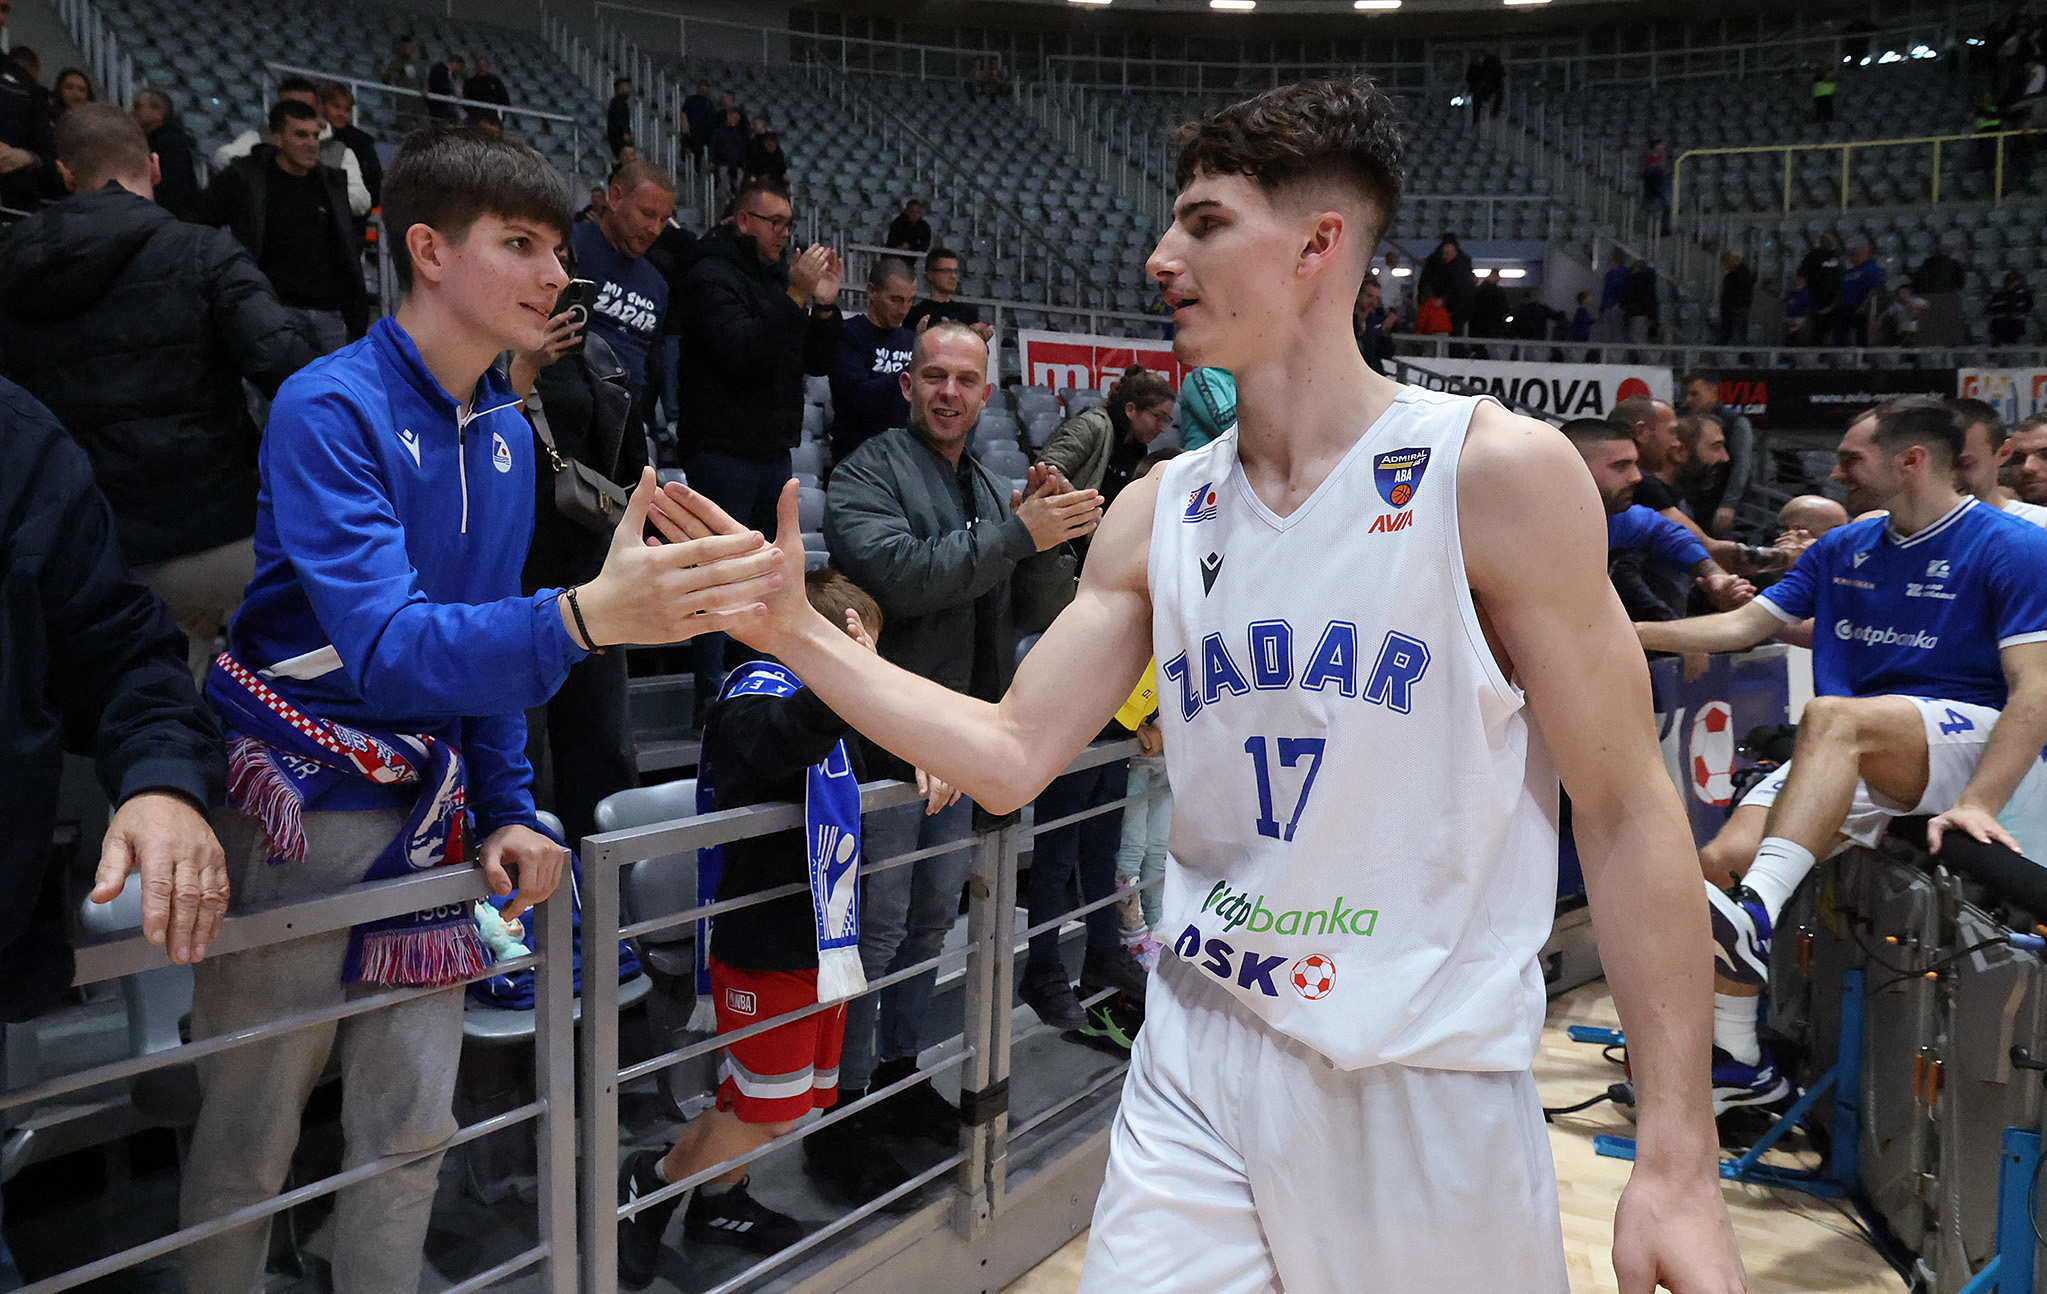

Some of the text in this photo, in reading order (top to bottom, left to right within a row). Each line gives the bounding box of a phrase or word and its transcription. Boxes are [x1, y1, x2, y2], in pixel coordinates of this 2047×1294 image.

[592, 293, 657, 332] ZADAR
[627, 291, 655, 311] SMO
[1381, 450, 1427, 464] ADMIRAL
[1394, 468, 1413, 483] ABA
[1368, 509, 1413, 534] AVIA
[1853, 625, 1939, 649] otpbanka
[1163, 619, 1432, 723] ZADAR
[1244, 735, 1327, 842] 17
[735, 993, 752, 1012] NBA
